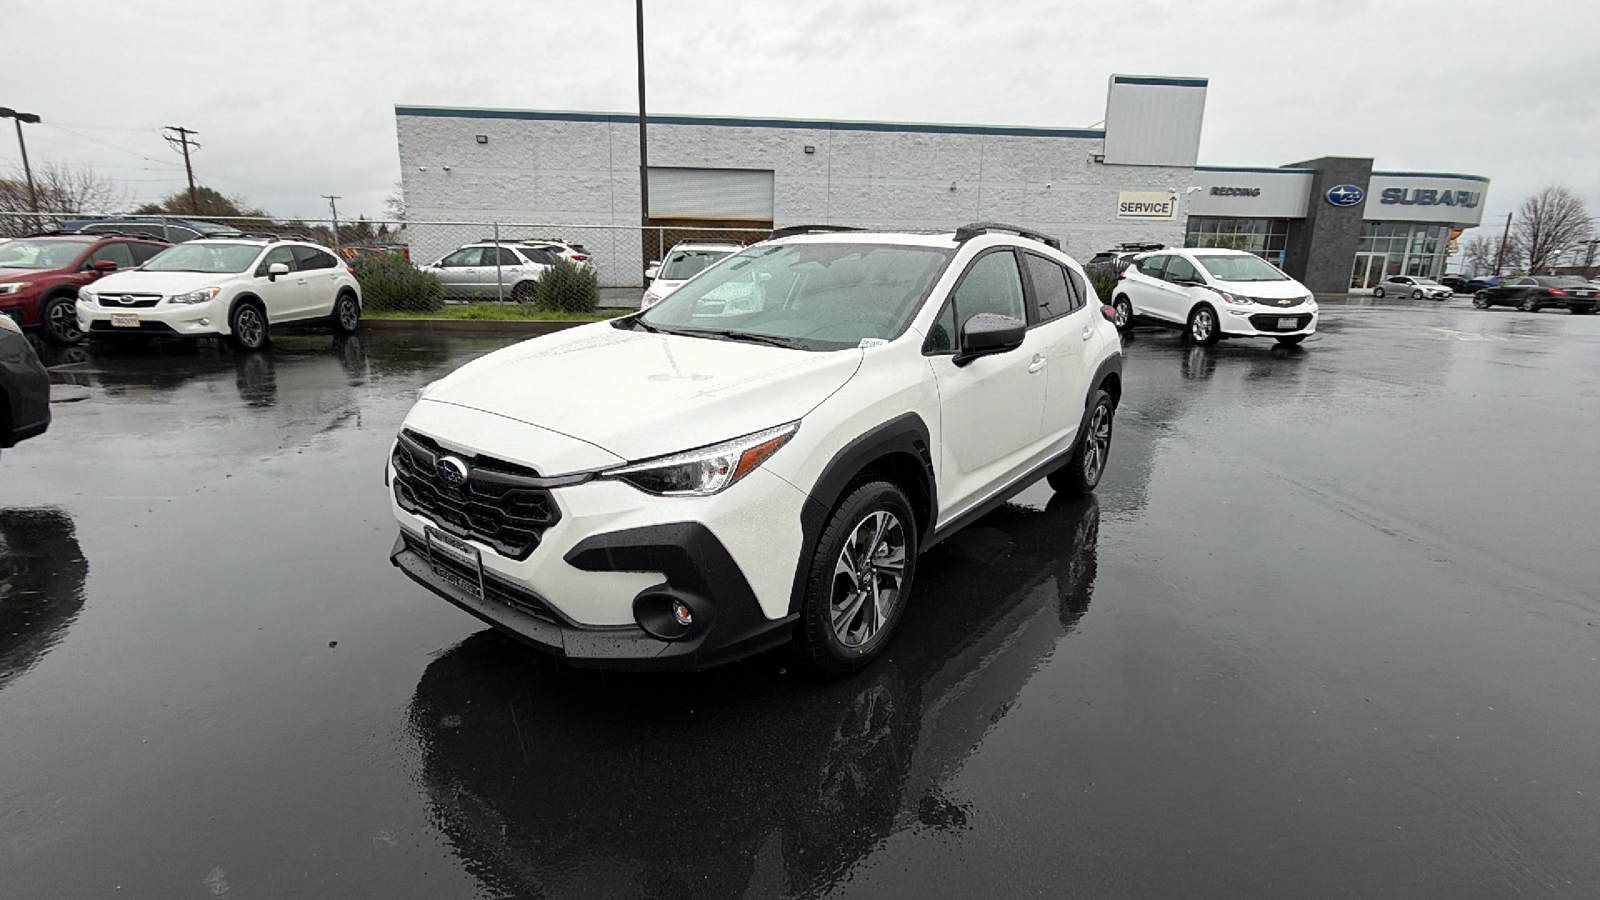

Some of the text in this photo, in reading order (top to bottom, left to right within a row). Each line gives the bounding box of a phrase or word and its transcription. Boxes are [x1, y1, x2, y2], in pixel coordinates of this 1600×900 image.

[1210, 186, 1260, 197] REDDING
[1381, 187, 1480, 208] SUBARU
[1119, 202, 1169, 213] SERVICE
